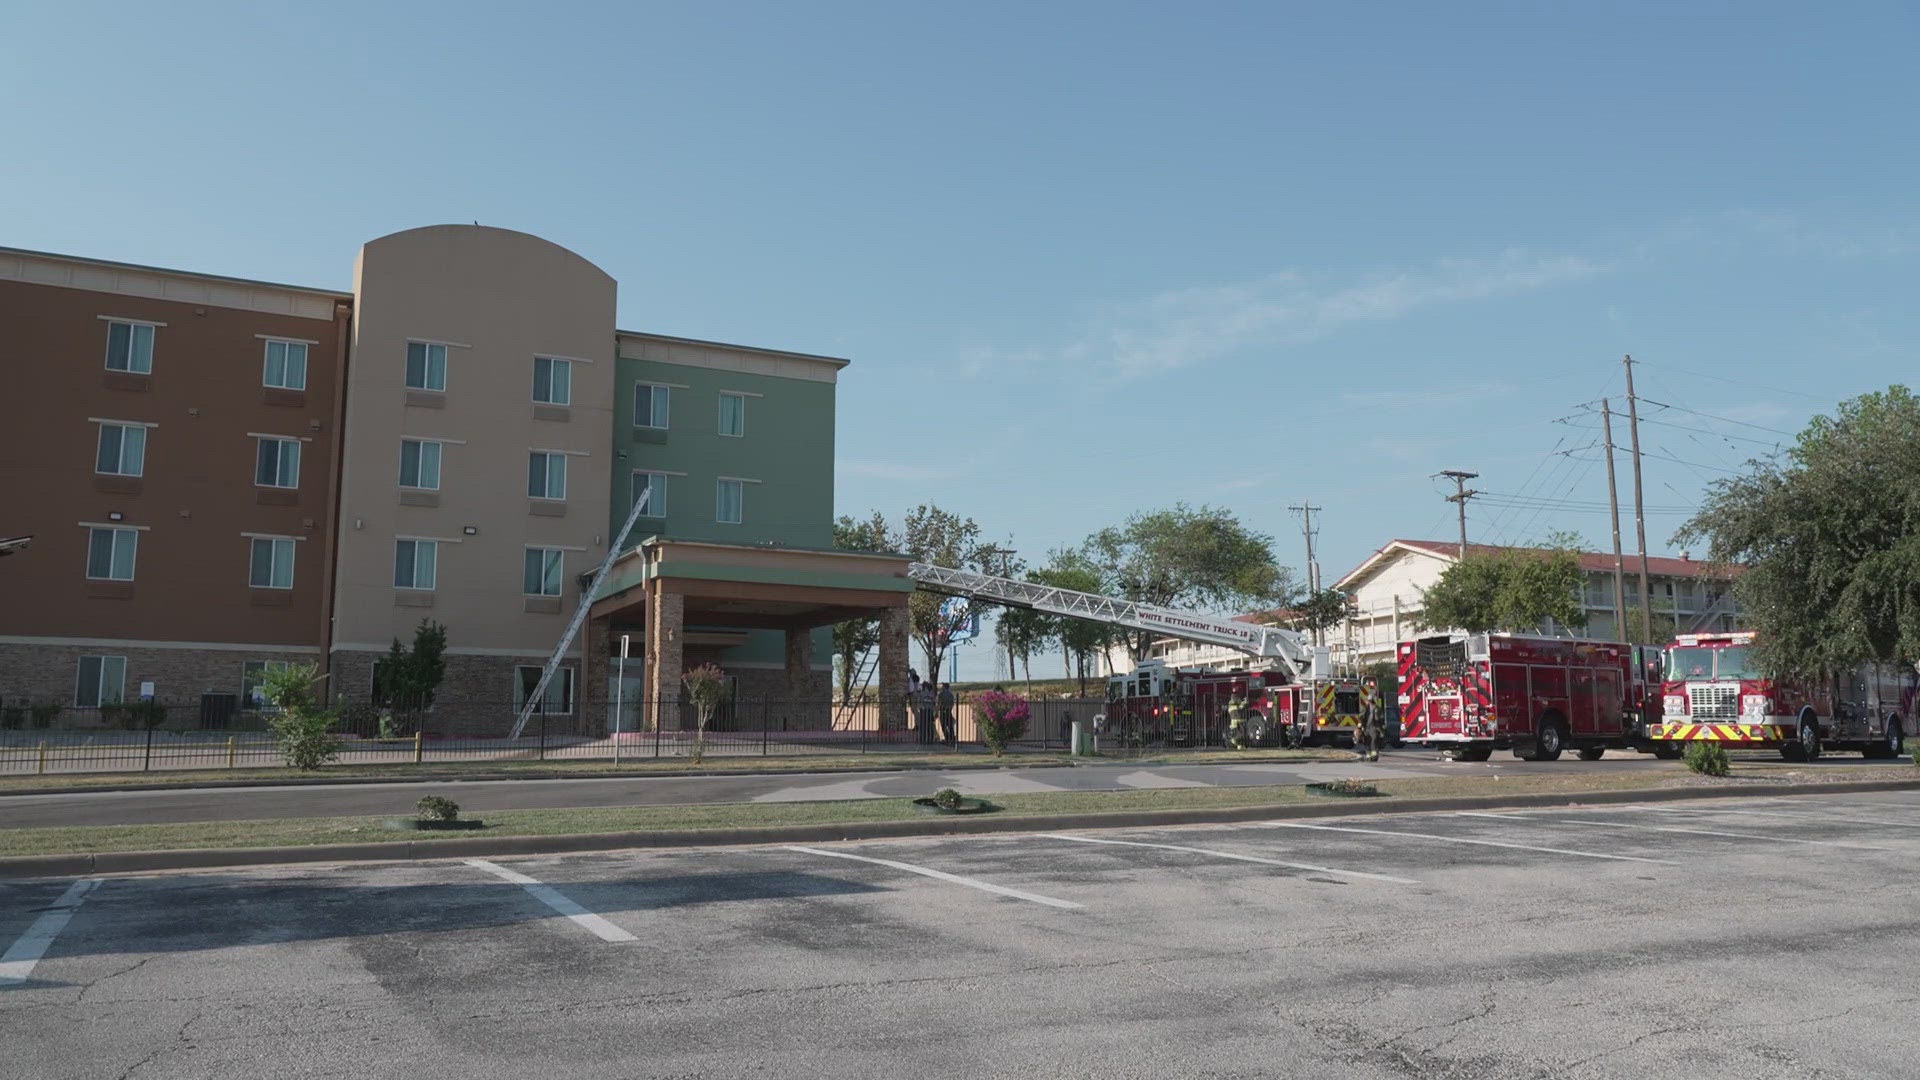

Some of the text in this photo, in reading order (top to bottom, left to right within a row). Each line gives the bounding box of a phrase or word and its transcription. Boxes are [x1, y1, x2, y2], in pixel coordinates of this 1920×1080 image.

[1138, 611, 1162, 621] WHITE
[1165, 616, 1211, 630] SETTLEMENT
[1213, 625, 1238, 636] TRUCK
[1280, 708, 1291, 724] 18
